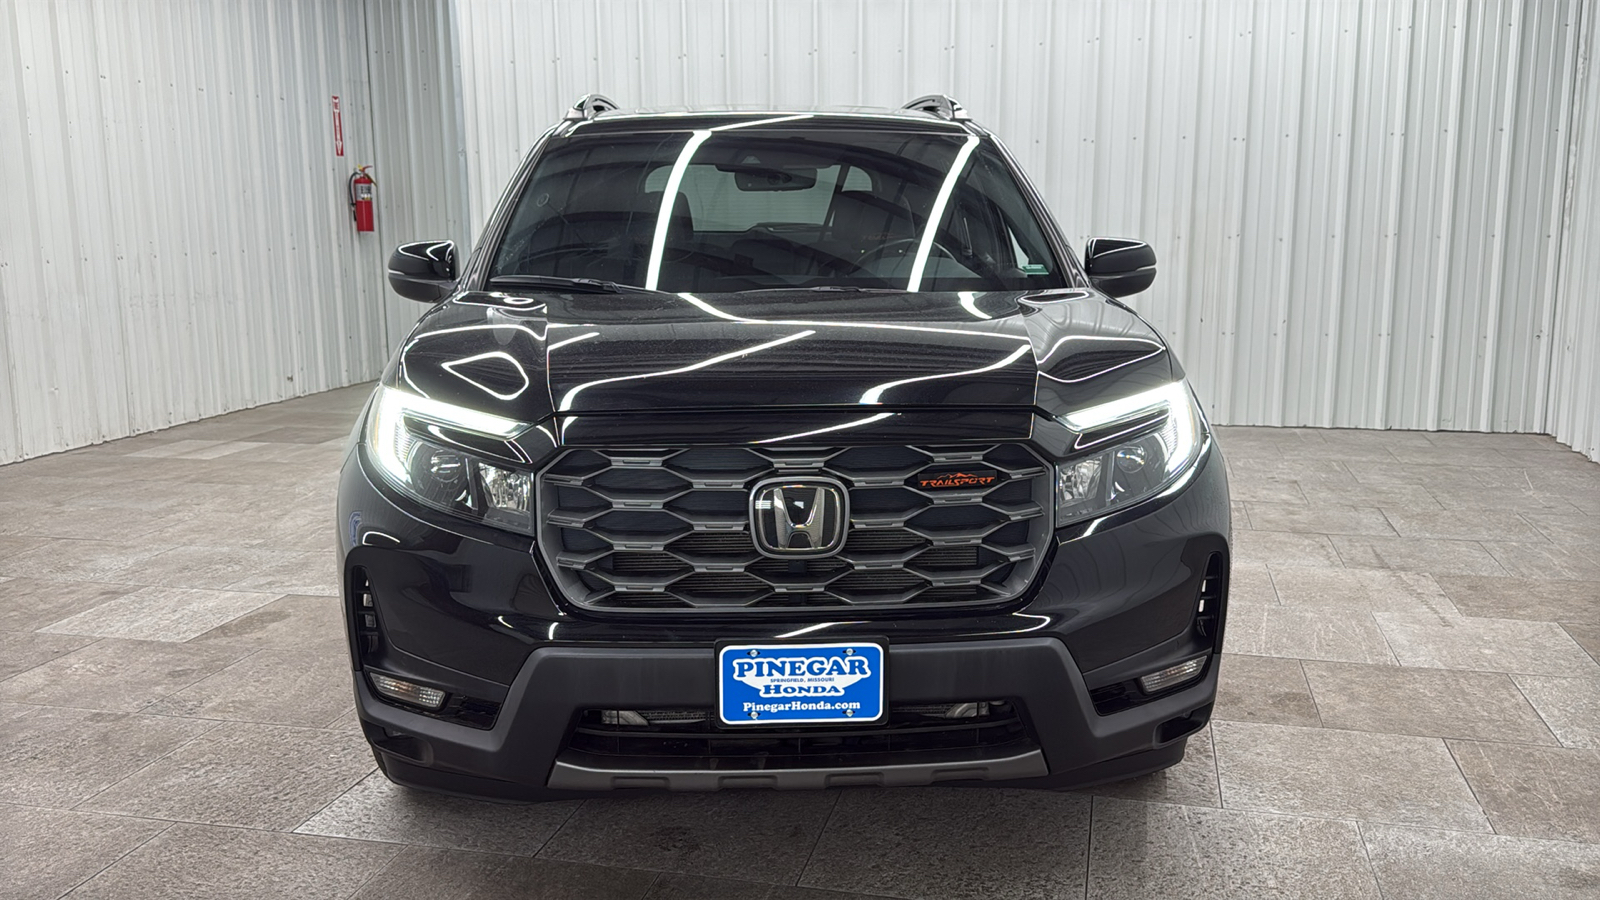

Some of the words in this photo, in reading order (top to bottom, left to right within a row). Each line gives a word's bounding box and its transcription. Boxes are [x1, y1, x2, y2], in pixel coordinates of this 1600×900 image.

[920, 477, 995, 487] TRAILSPORT
[736, 659, 867, 677] PINEGAR
[743, 701, 860, 712] PinegarHonda.com
